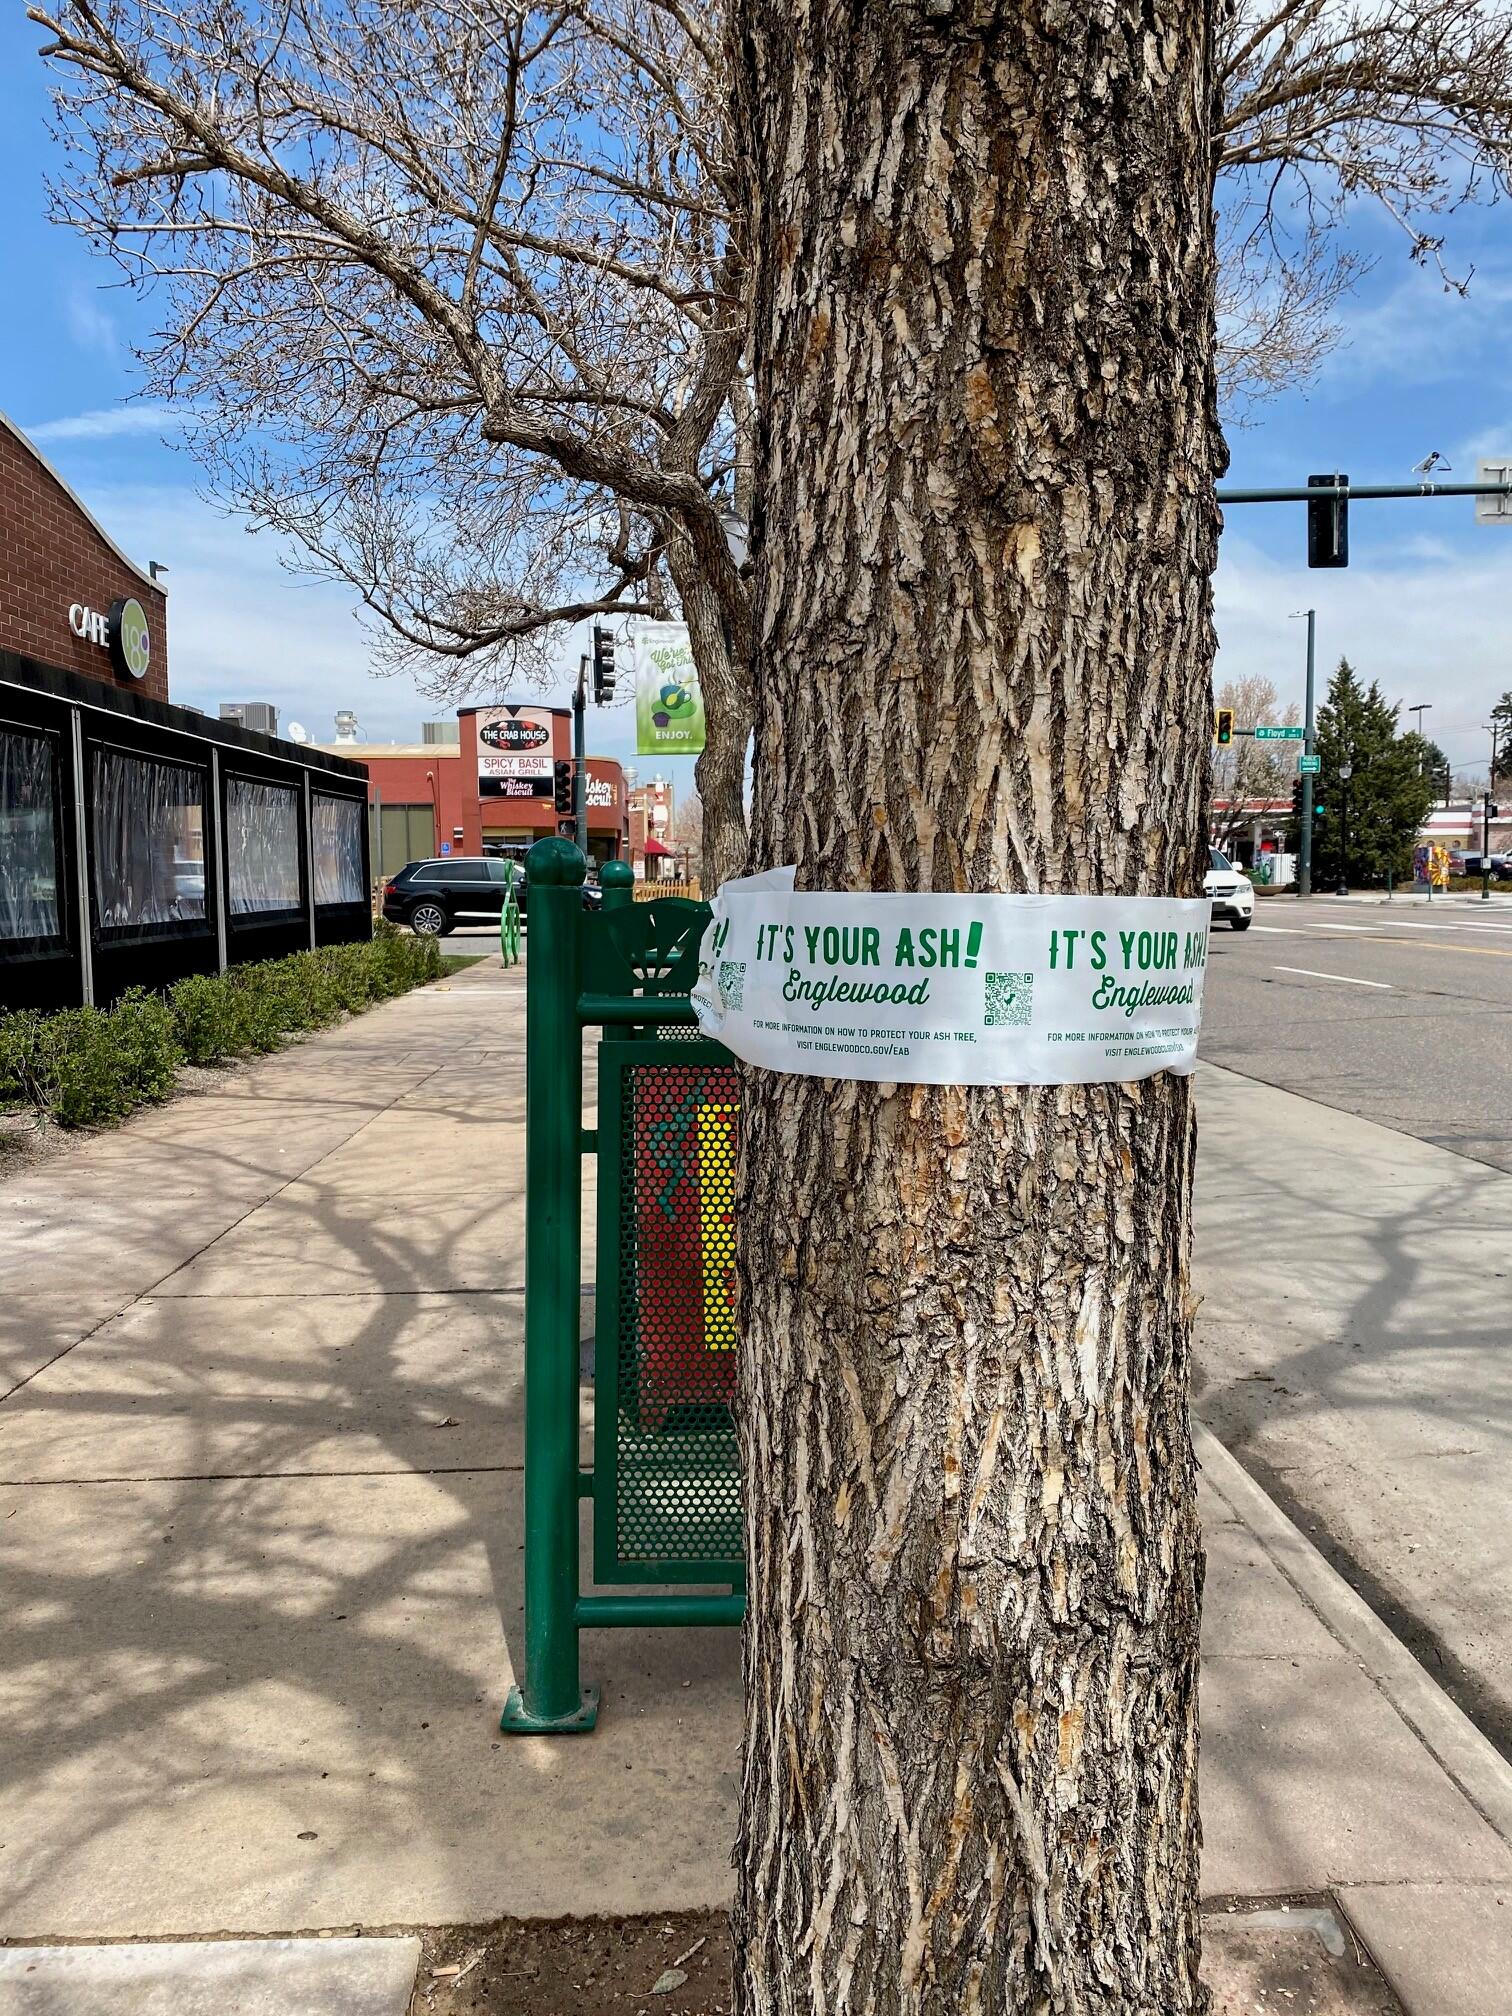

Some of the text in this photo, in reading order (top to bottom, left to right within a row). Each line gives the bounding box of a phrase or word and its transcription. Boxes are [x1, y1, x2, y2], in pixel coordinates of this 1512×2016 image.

[69, 603, 110, 648] CAFE
[483, 730, 547, 740] THE CRAB HOUSE
[655, 731, 693, 740] ENJOY.
[1267, 729, 1286, 739] Floyd
[484, 758, 548, 769] SPICY BASIL
[500, 781, 533, 790] Whiskey
[585, 772, 612, 794] iskey
[506, 787, 533, 796] Biscuit
[585, 793, 612, 807] scuit
[756, 923, 795, 964] IT'S
[804, 925, 880, 967] YOUR
[894, 921, 984, 969] ASH!
[1048, 924, 1208, 970] IT'S YOUR ASH!
[782, 967, 931, 1011] Englewood
[1092, 974, 1194, 1018] Englewood
[753, 1019, 977, 1044] FOR MORE INFORMATION ON HOW TO PROTECT YOUR ASH TREE,
[1047, 1032, 1062, 1042] FOR
[1065, 1032, 1086, 1042] MORE
[1088, 1032, 1134, 1041] INFORMATION
[1136, 1031, 1144, 1040] ON
[796, 1040, 910, 1056] VISIT ENGLEWOODCO.GOV/EAB
[1105, 1048, 1123, 1057] VISIT
